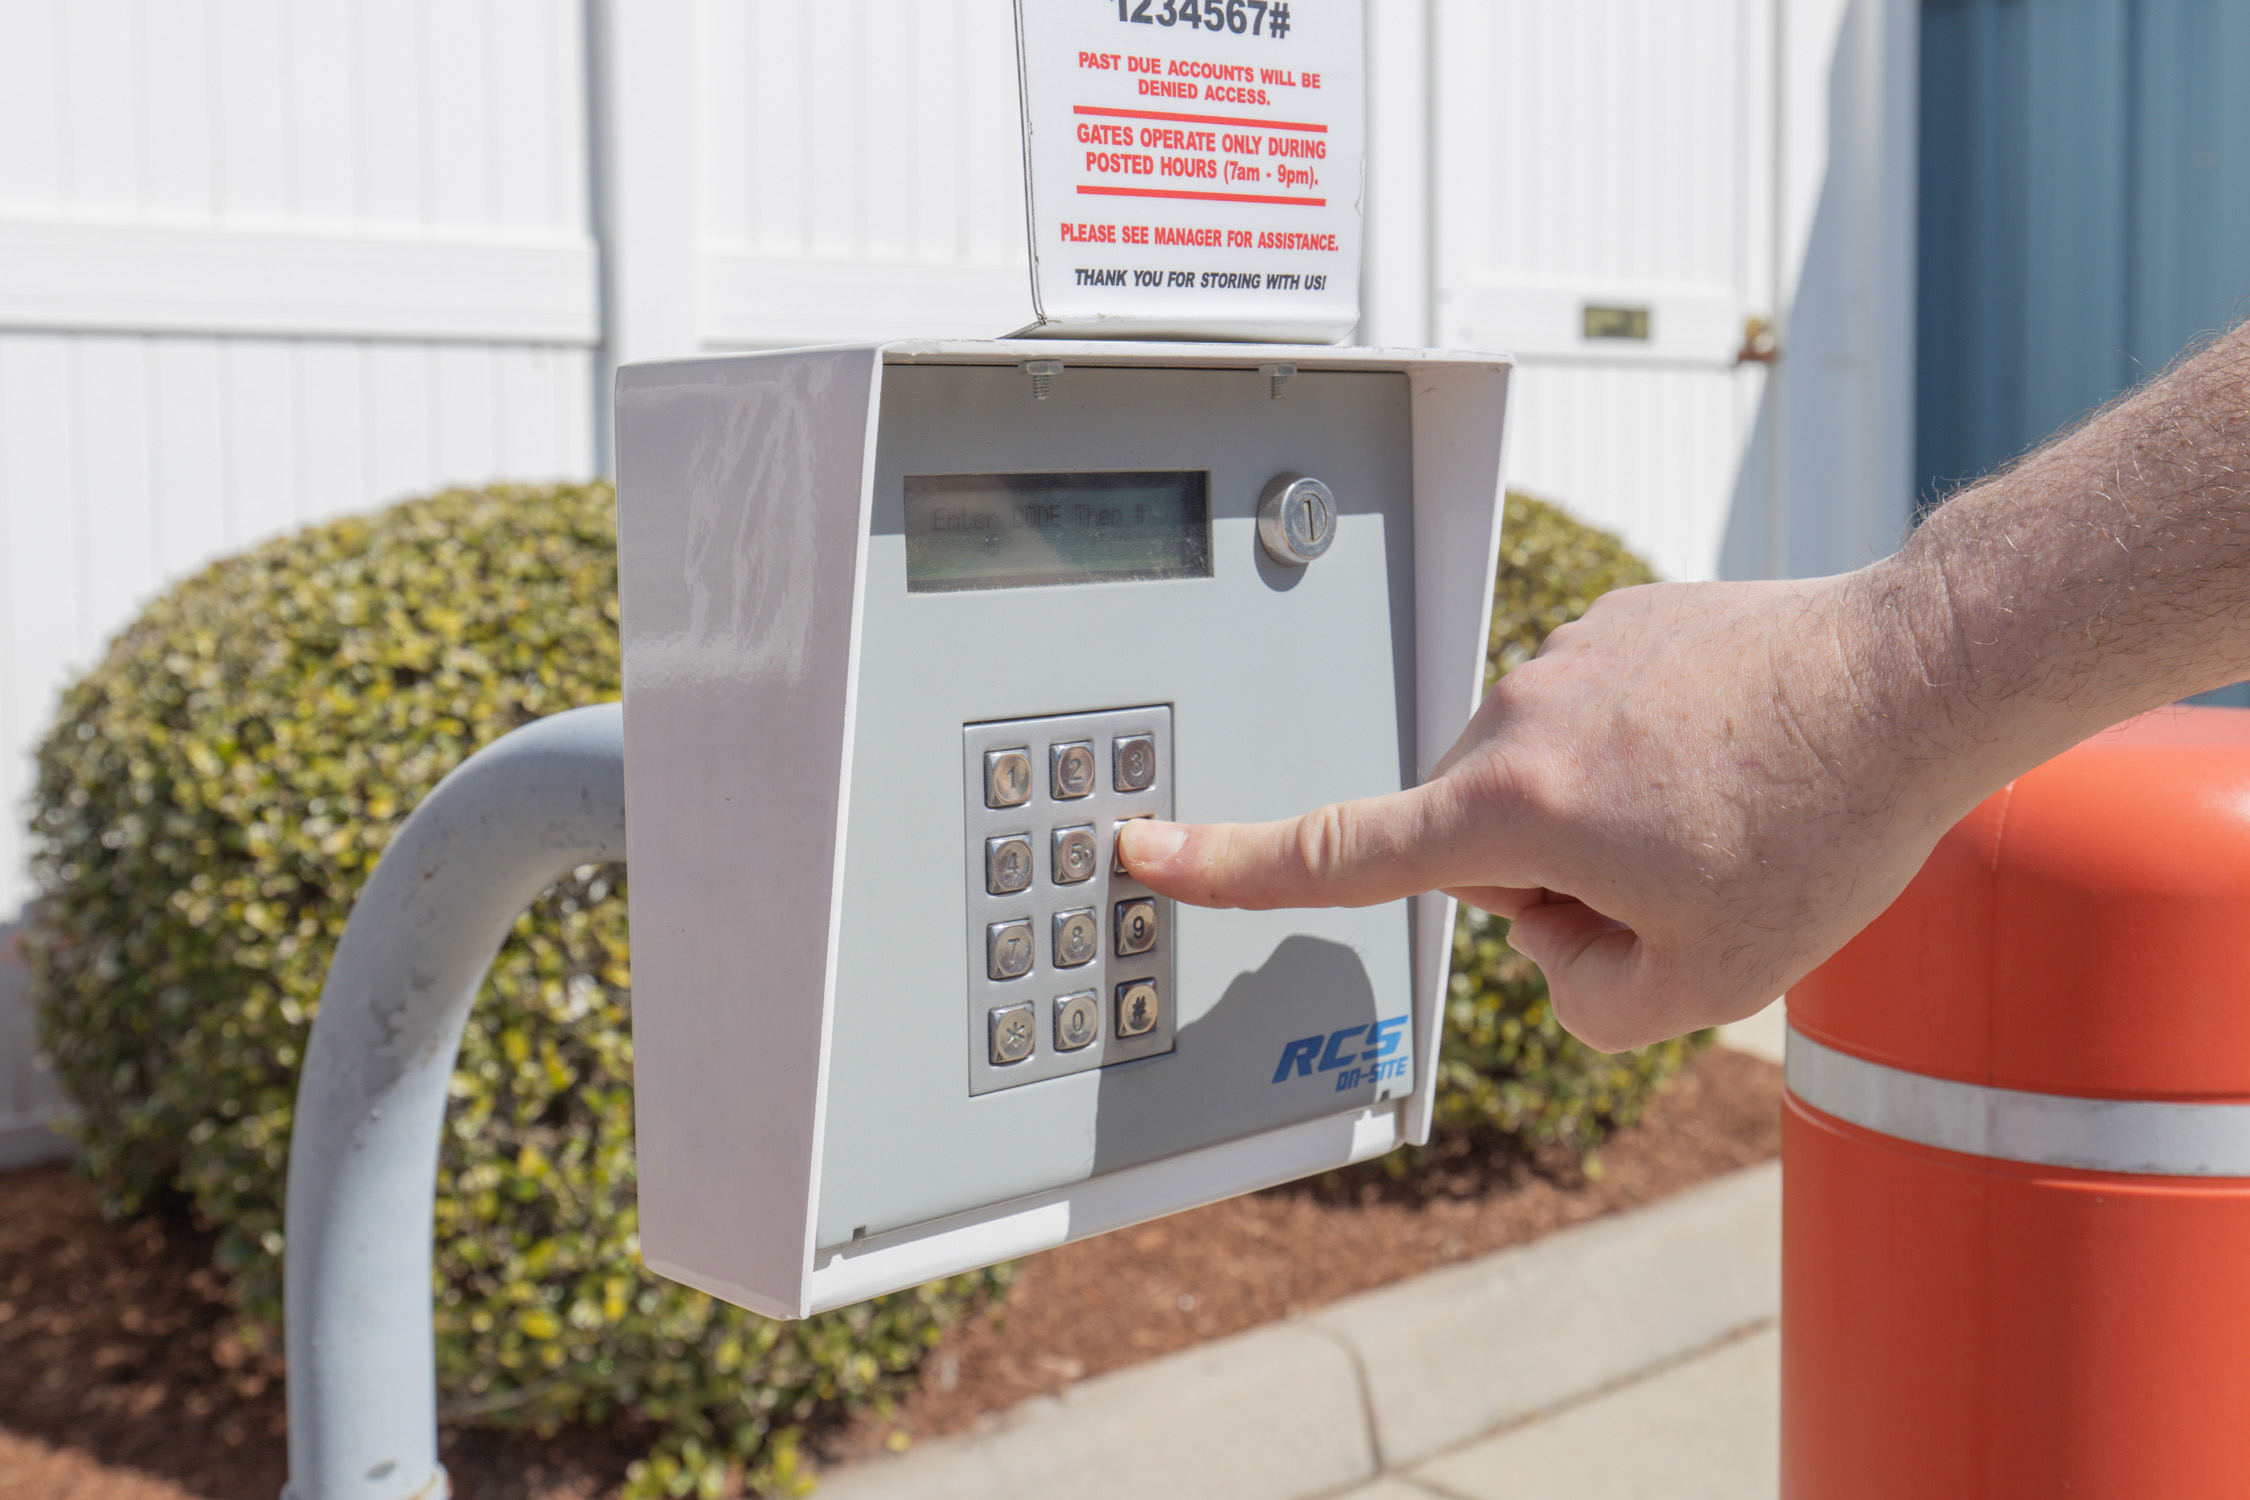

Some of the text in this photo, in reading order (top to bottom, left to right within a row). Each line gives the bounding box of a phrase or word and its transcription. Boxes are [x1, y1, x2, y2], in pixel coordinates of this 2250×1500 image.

[1079, 52, 1321, 89] PAST DUE ACCOUNTS WILL BE
[1138, 79, 1271, 105] DENIED ACCESS.
[1077, 123, 1326, 159] GATES OPERATE ONLY DURING
[1086, 152, 1153, 175] POSTED
[1161, 156, 1217, 178] HOURS
[1224, 160, 1260, 184] (7am
[1278, 164, 1318, 189] 9pm).
[1061, 223, 1338, 251] PLEASE SEE MANAGER FOR ASSISTANCE.
[1075, 269, 1326, 290] THANK YOU FOR STORING WITH US!
[932, 501, 1147, 532] Enter CODE Then #
[1006, 751, 1144, 793] 1 2 3
[1005, 851, 1020, 874] 4
[1007, 914, 1146, 961] 7 8 9
[1070, 1008, 1086, 1035] 0
[1271, 1014, 1409, 1084] RCS
[1335, 1055, 1409, 1092] ON-SITE
